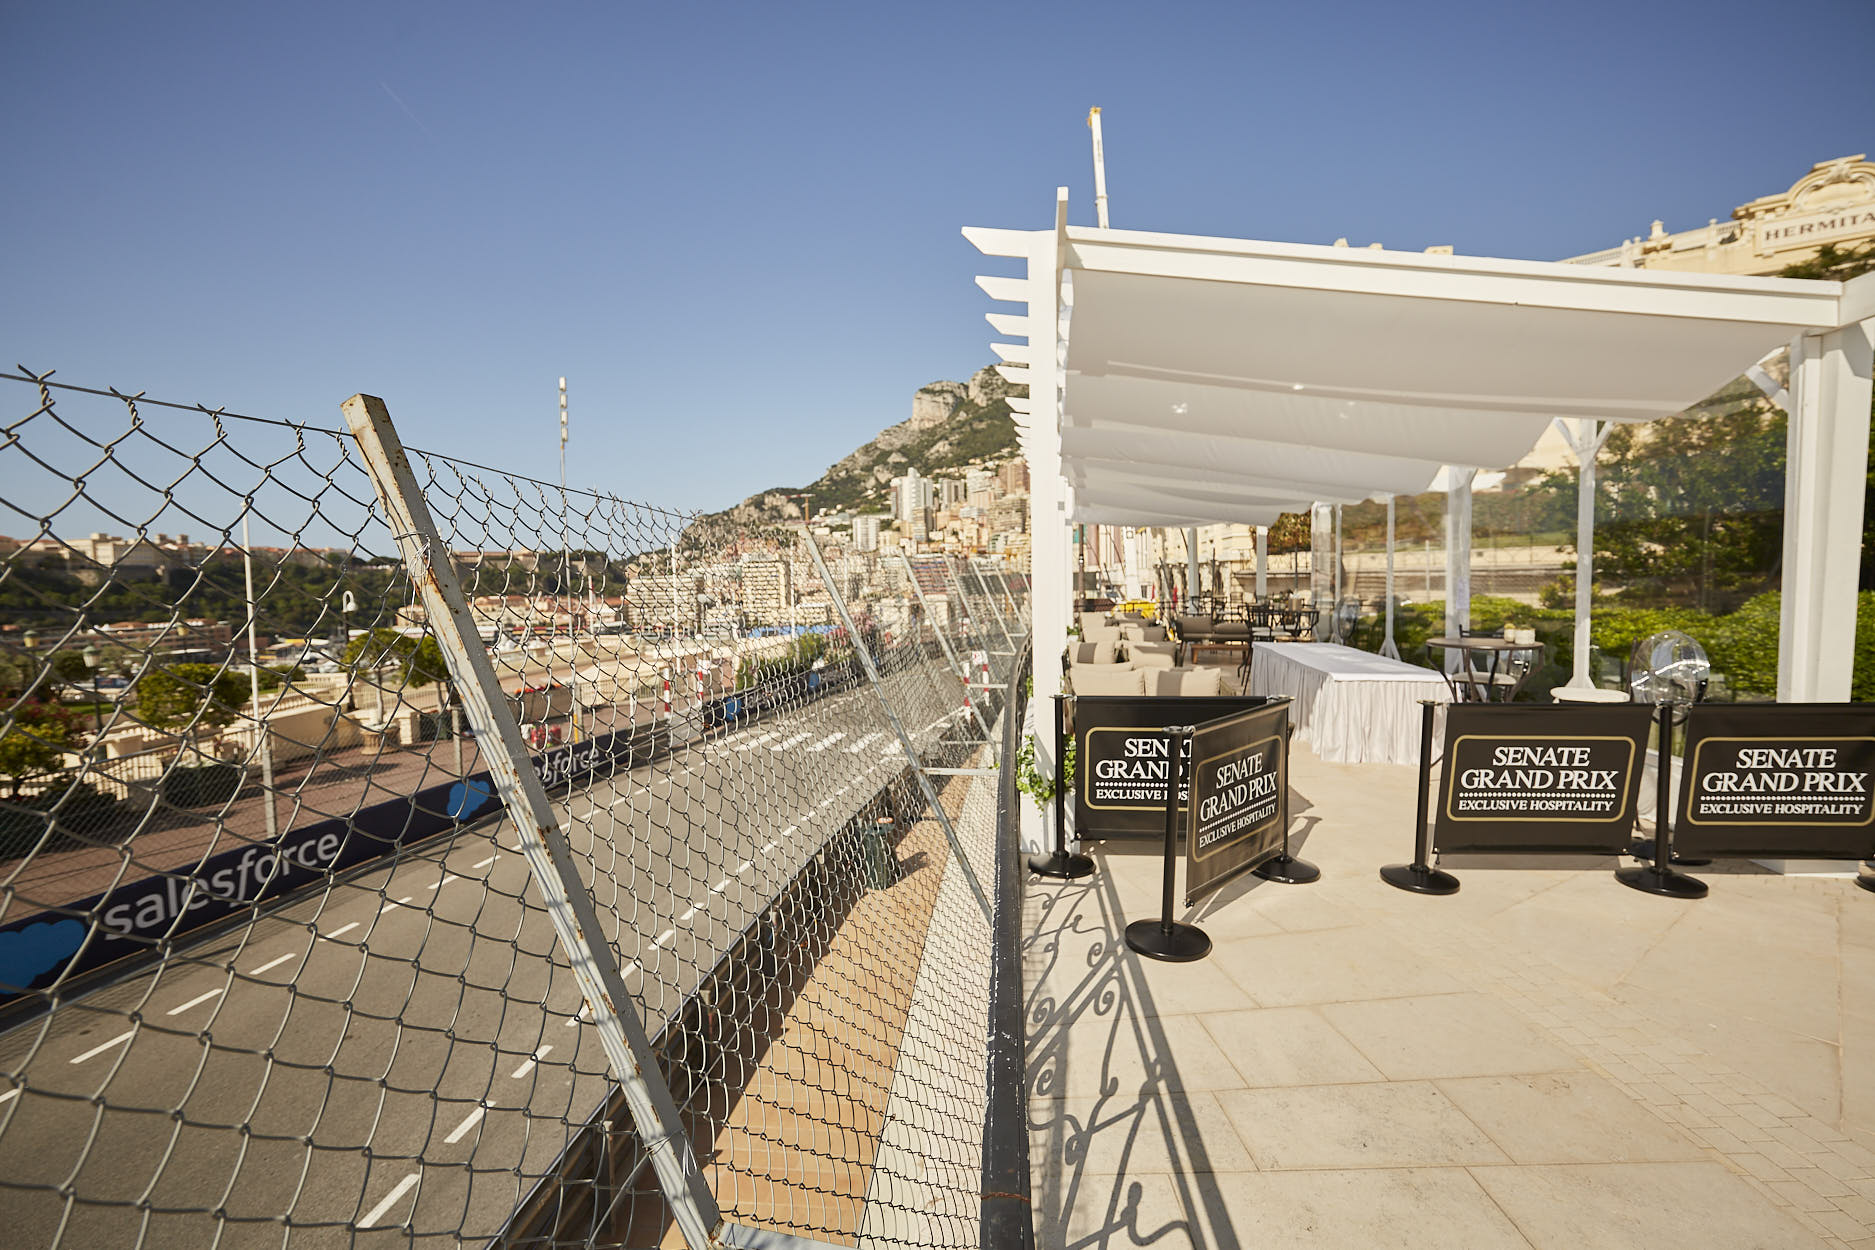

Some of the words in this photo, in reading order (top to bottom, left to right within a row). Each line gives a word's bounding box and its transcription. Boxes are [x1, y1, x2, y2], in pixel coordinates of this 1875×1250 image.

[1765, 212, 1875, 241] HERMITA
[1124, 738, 1192, 758] SENT
[1492, 746, 1591, 767] SENATE
[1735, 748, 1837, 769] SENATE
[1216, 752, 1263, 789] SENATE
[1460, 768, 1554, 790] GRAND
[1556, 770, 1619, 790] PRIX
[1702, 772, 1800, 793] GRAND
[1802, 772, 1868, 793] PRIX
[1096, 789, 1162, 800] EXCLUSIVE
[1200, 784, 1248, 822] GRAND
[1248, 771, 1277, 801] PRIX
[1458, 799, 1528, 811] EXCLUSIVE
[1530, 800, 1613, 812] HOSPITALITY
[1700, 803, 1772, 814] EXCLUSIVE
[1774, 804, 1863, 815] HOSPITALITY
[1200, 820, 1237, 848] EXCLUSIVE
[1236, 802, 1276, 830] HOSPITALITY
[103, 832, 340, 941] salesforce
